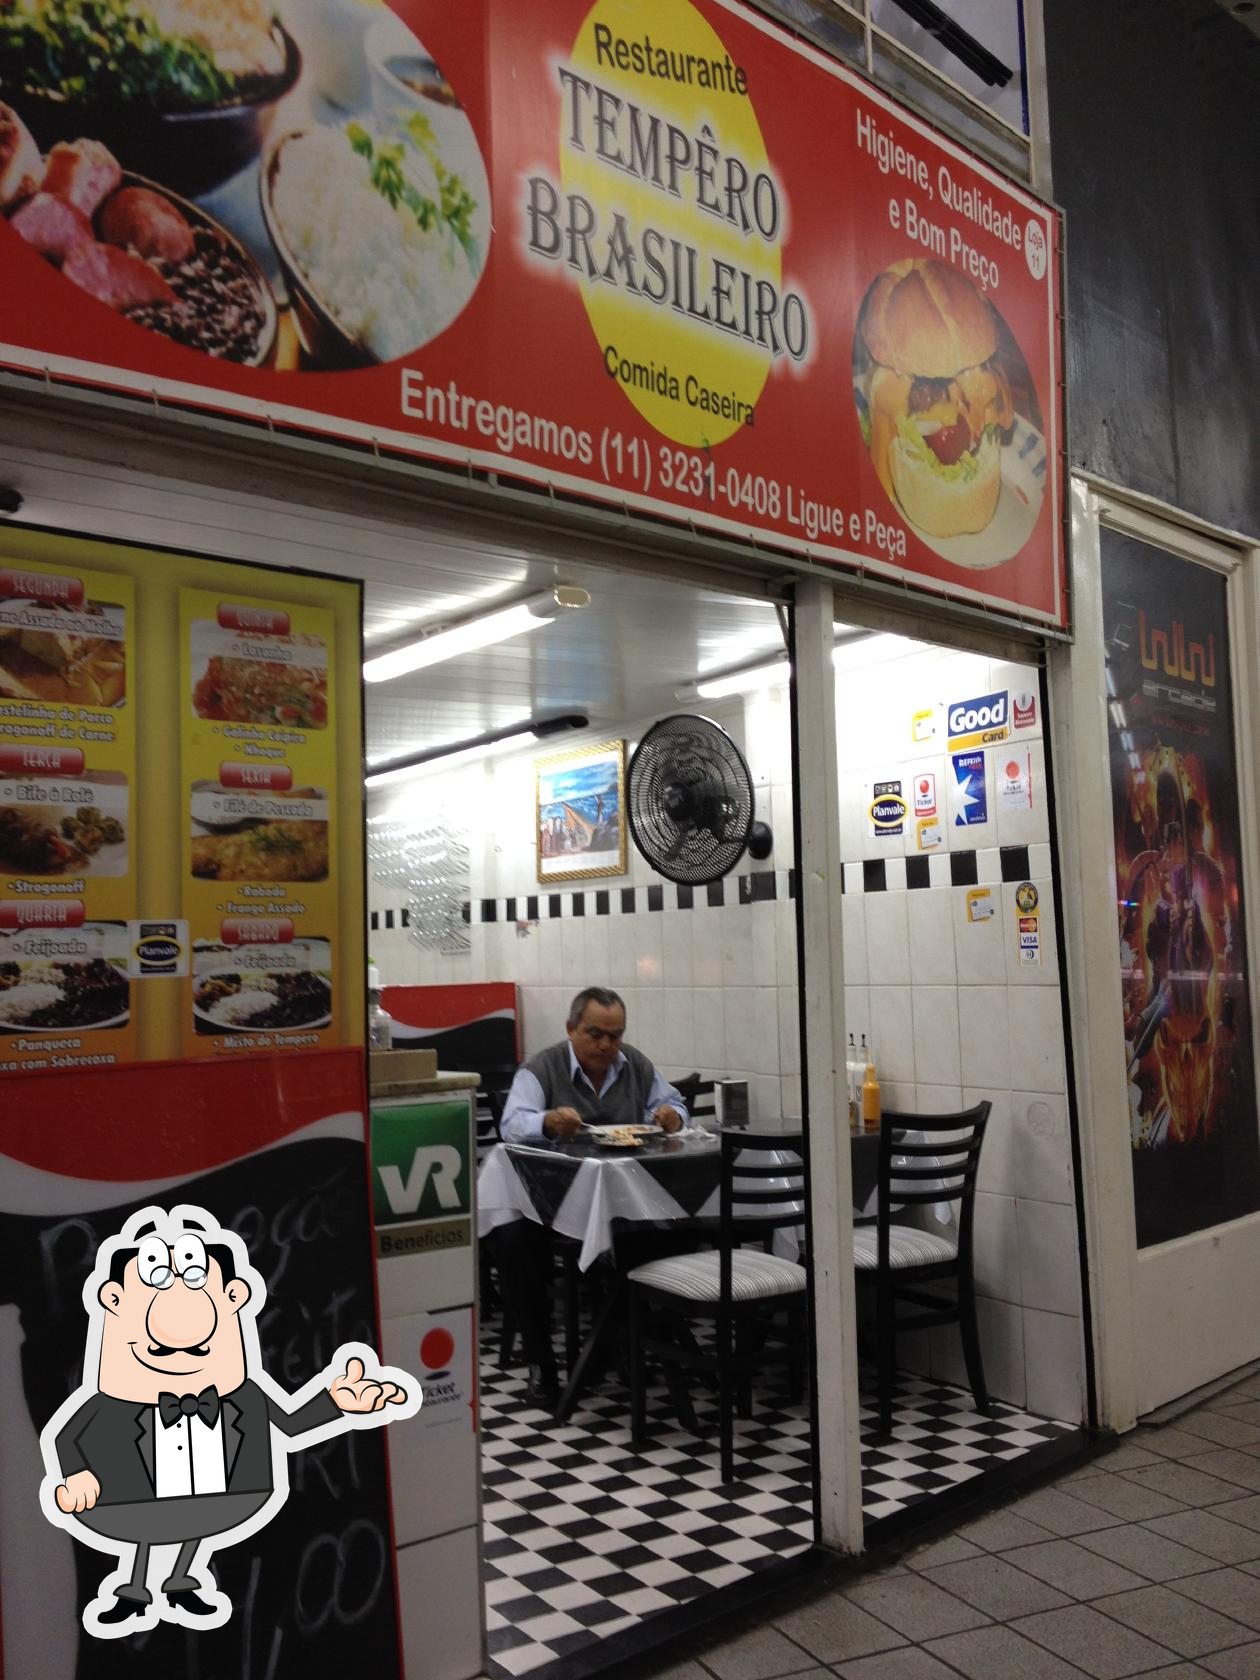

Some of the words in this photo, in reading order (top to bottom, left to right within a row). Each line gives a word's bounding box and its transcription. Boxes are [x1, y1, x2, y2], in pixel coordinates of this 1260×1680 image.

[594, 22, 748, 96] Restaurante
[558, 66, 778, 241] TEMPÊRO
[856, 107, 934, 201] Higiene,
[938, 166, 1022, 251] Qualidade
[527, 177, 807, 362] BRASILEIRO
[889, 199, 900, 229] e
[905, 199, 946, 257] Bom
[950, 227, 999, 291] Preço
[604, 345, 679, 401] Comida
[686, 375, 755, 427] Caseira
[401, 367, 593, 465] Entregamos
[601, 427, 652, 493] (11)
[660, 446, 781, 520] 3231-0408
[787, 485, 844, 540] Ligue
[849, 513, 861, 541] e
[865, 509, 906, 561] Peça
[949, 698, 1005, 733] Good
[982, 730, 1004, 743] Card
[873, 802, 905, 817] Planvale
[15, 903, 67, 924] QUARTA
[23, 938, 88, 957] Feijoada
[1022, 936, 1038, 944] VISA
[18, 1037, 82, 1052] Panqueca
[21, 1058, 48, 1070] com
[51, 1053, 116, 1068] Sobrecoxa
[377, 1144, 462, 1214] VR
